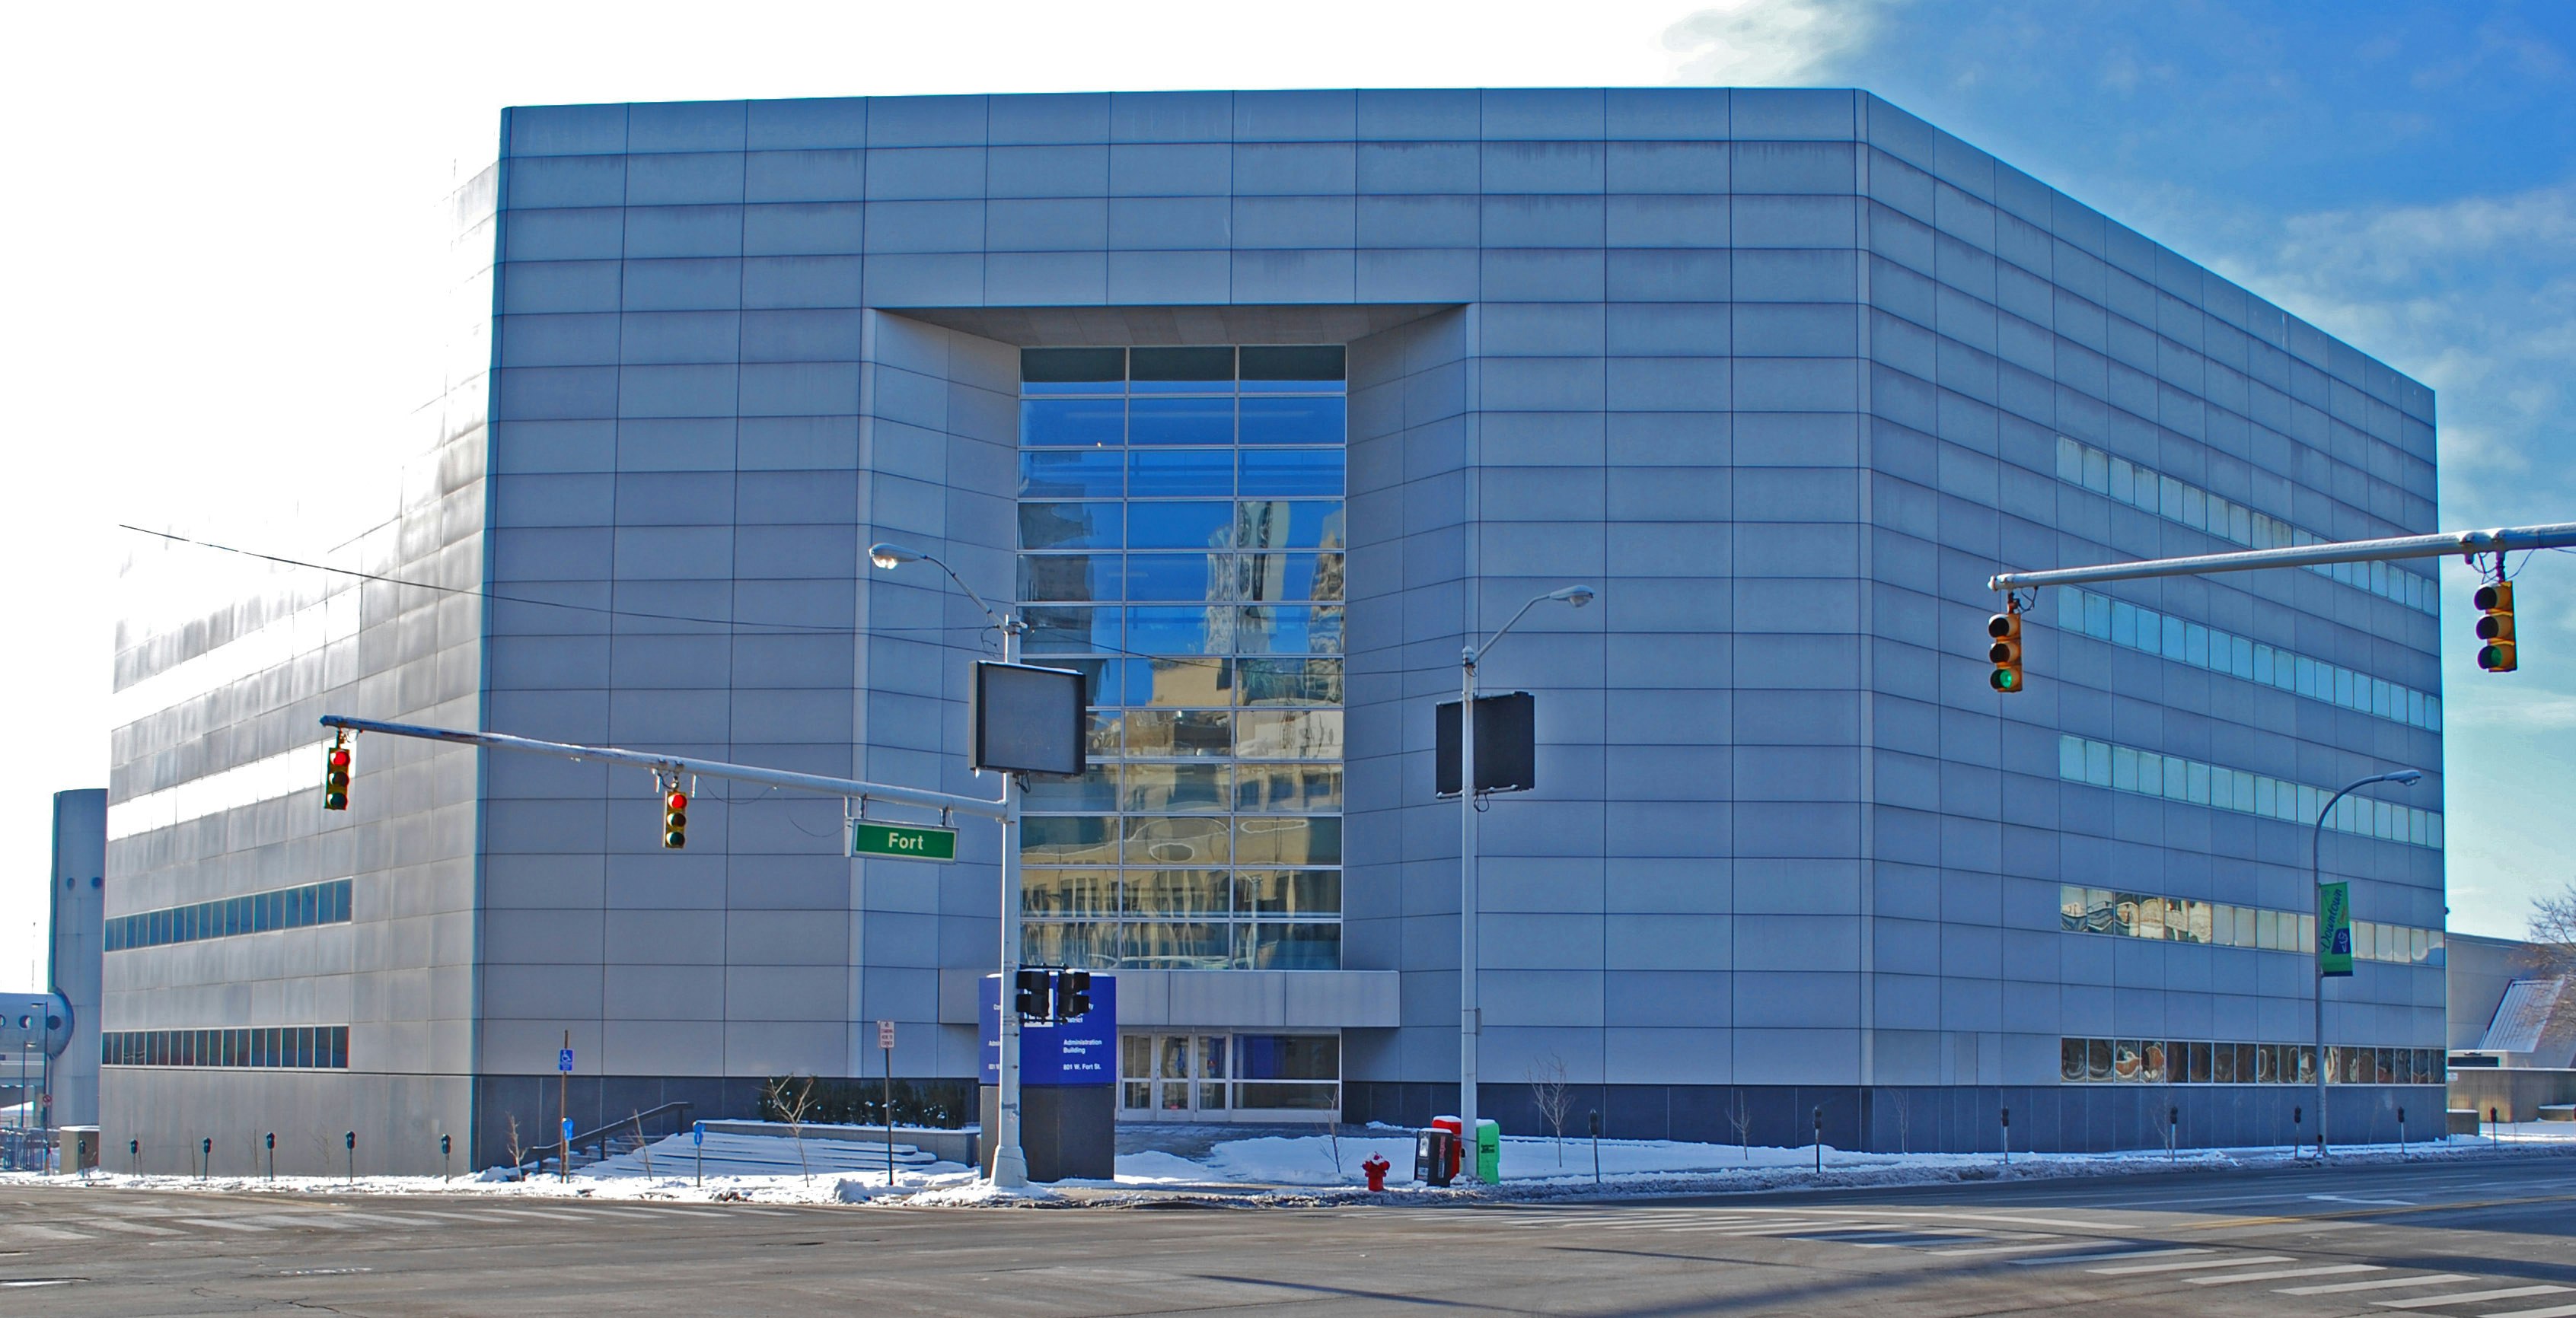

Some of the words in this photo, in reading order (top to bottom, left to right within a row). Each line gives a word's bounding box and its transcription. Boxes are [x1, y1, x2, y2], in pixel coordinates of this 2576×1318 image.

[888, 832, 924, 850] Fort
[2320, 888, 2342, 953] Downtown
[1063, 1046, 1086, 1055] Building
